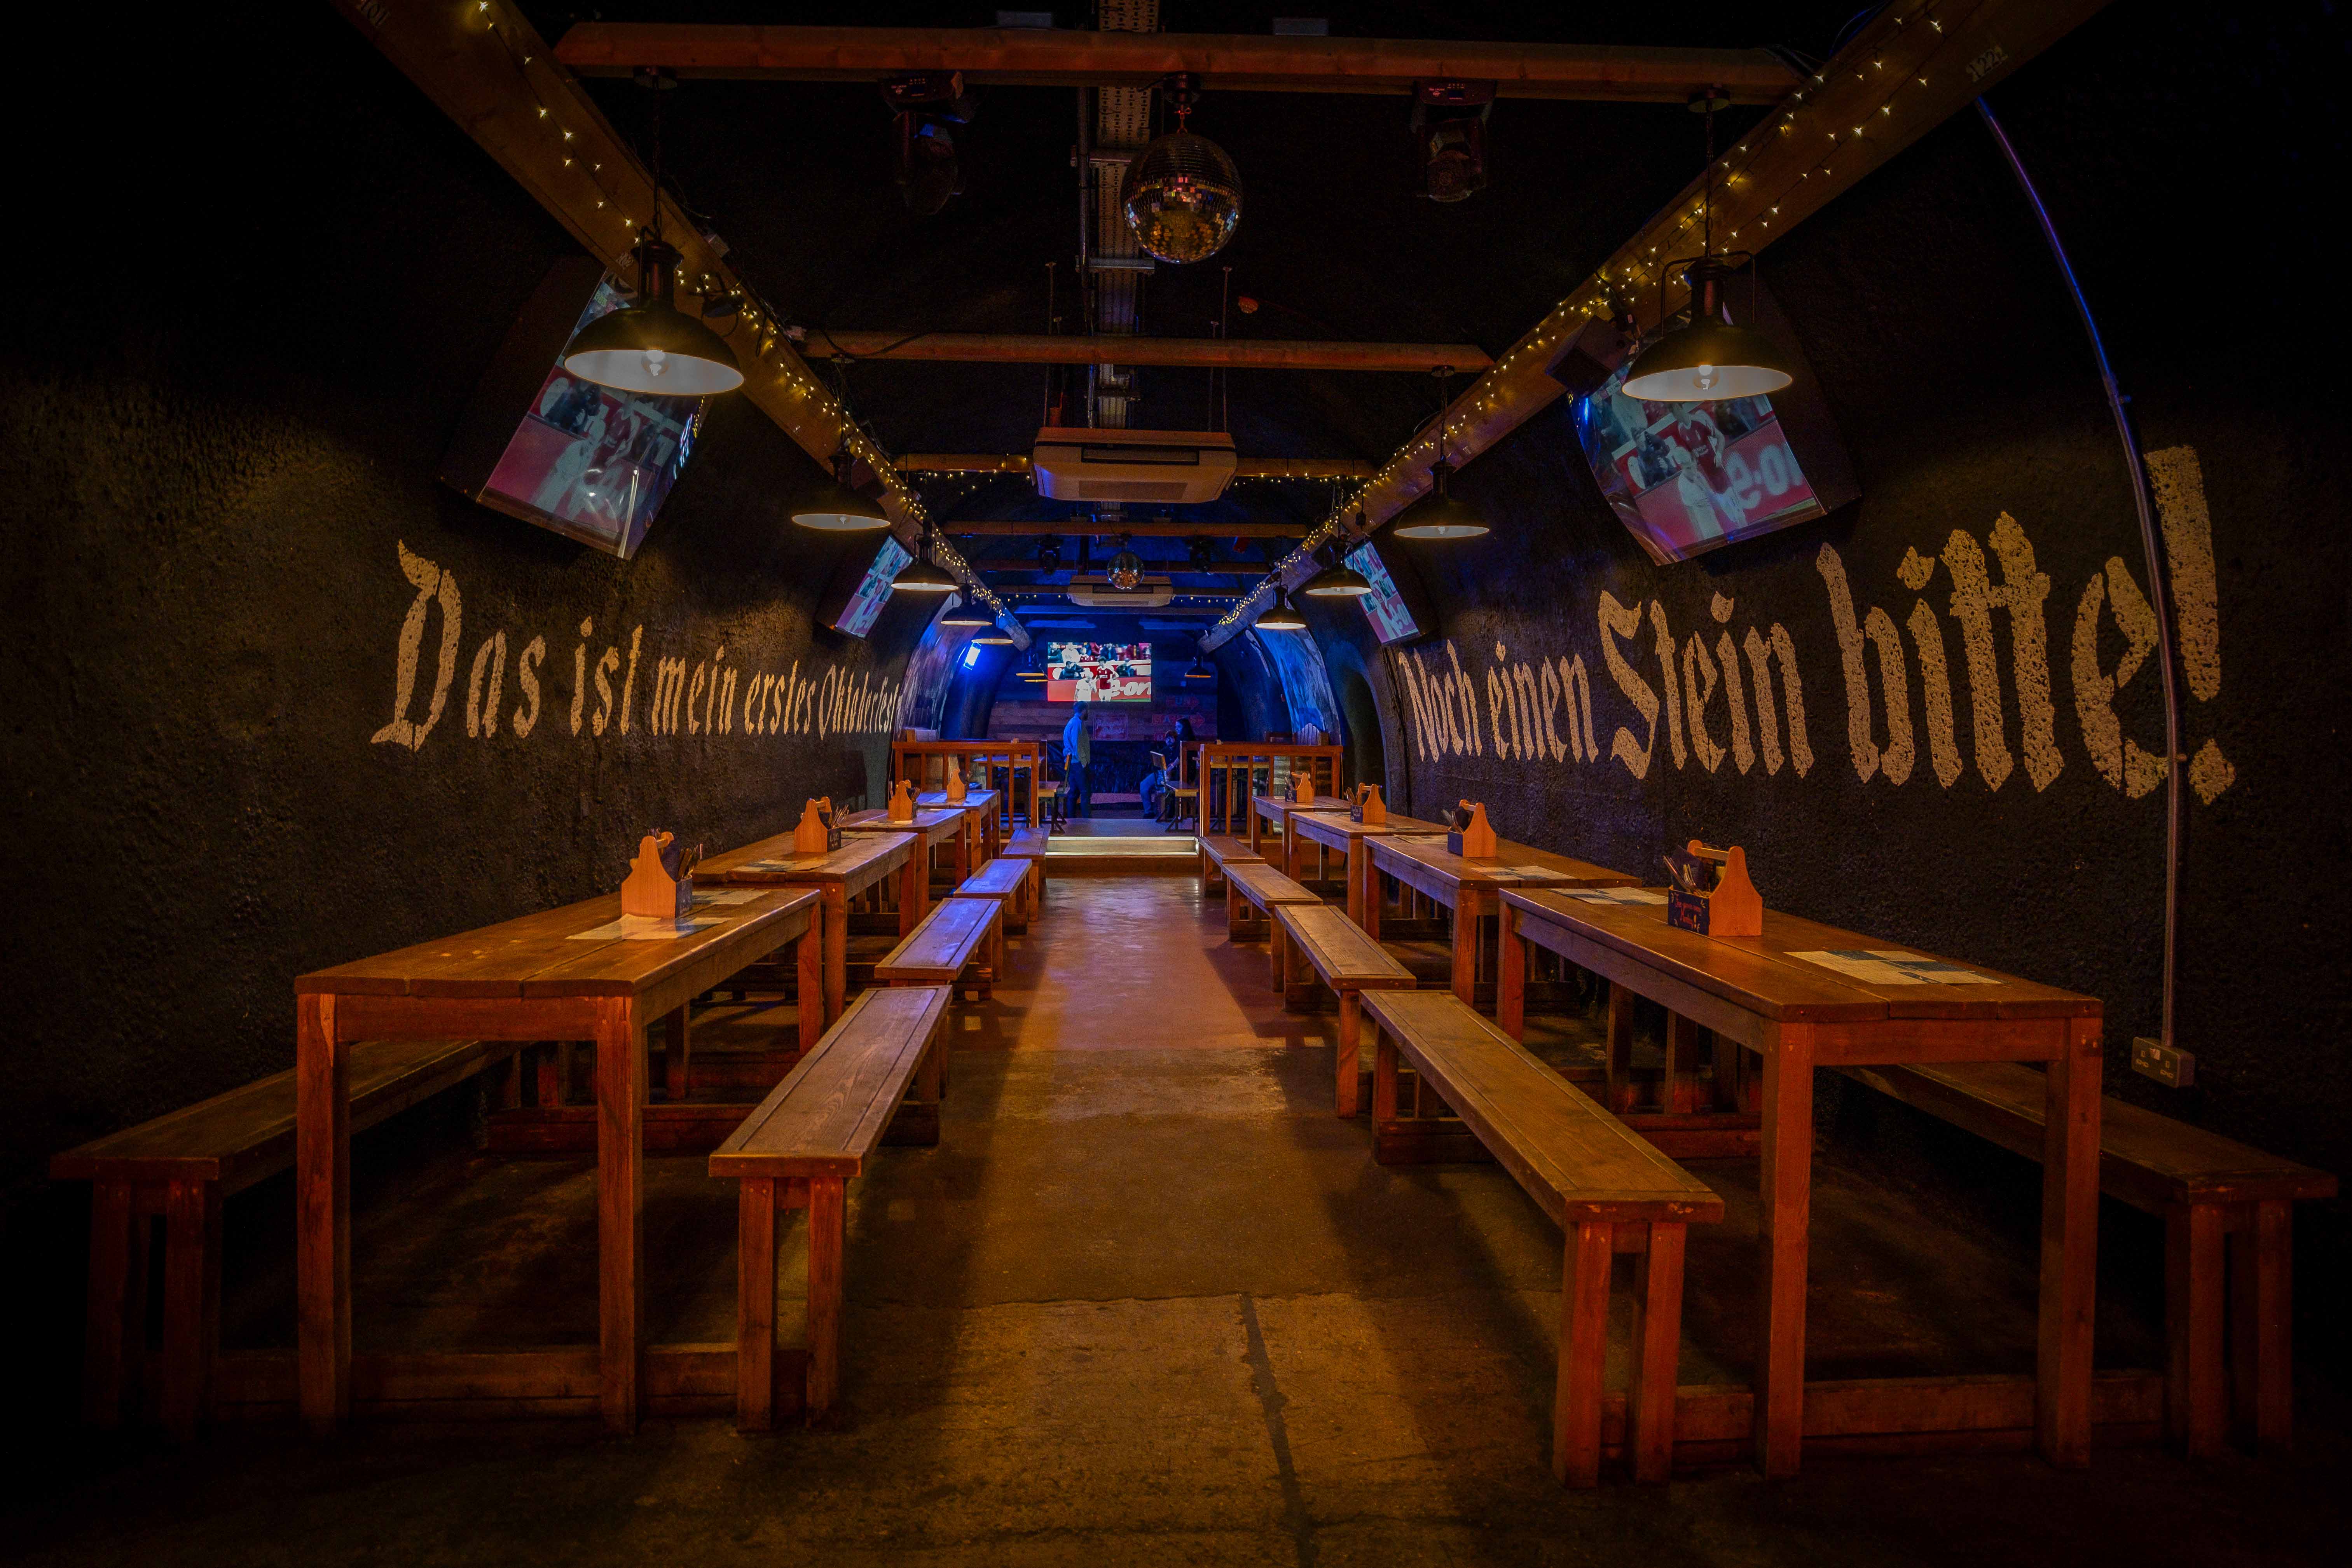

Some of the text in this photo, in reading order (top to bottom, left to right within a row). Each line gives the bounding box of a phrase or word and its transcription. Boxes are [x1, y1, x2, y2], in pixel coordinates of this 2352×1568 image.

[371, 540, 899, 752] Das ist mein erstes Oktoberfest
[1399, 445, 2235, 805] Noch einen Stein bitte!
